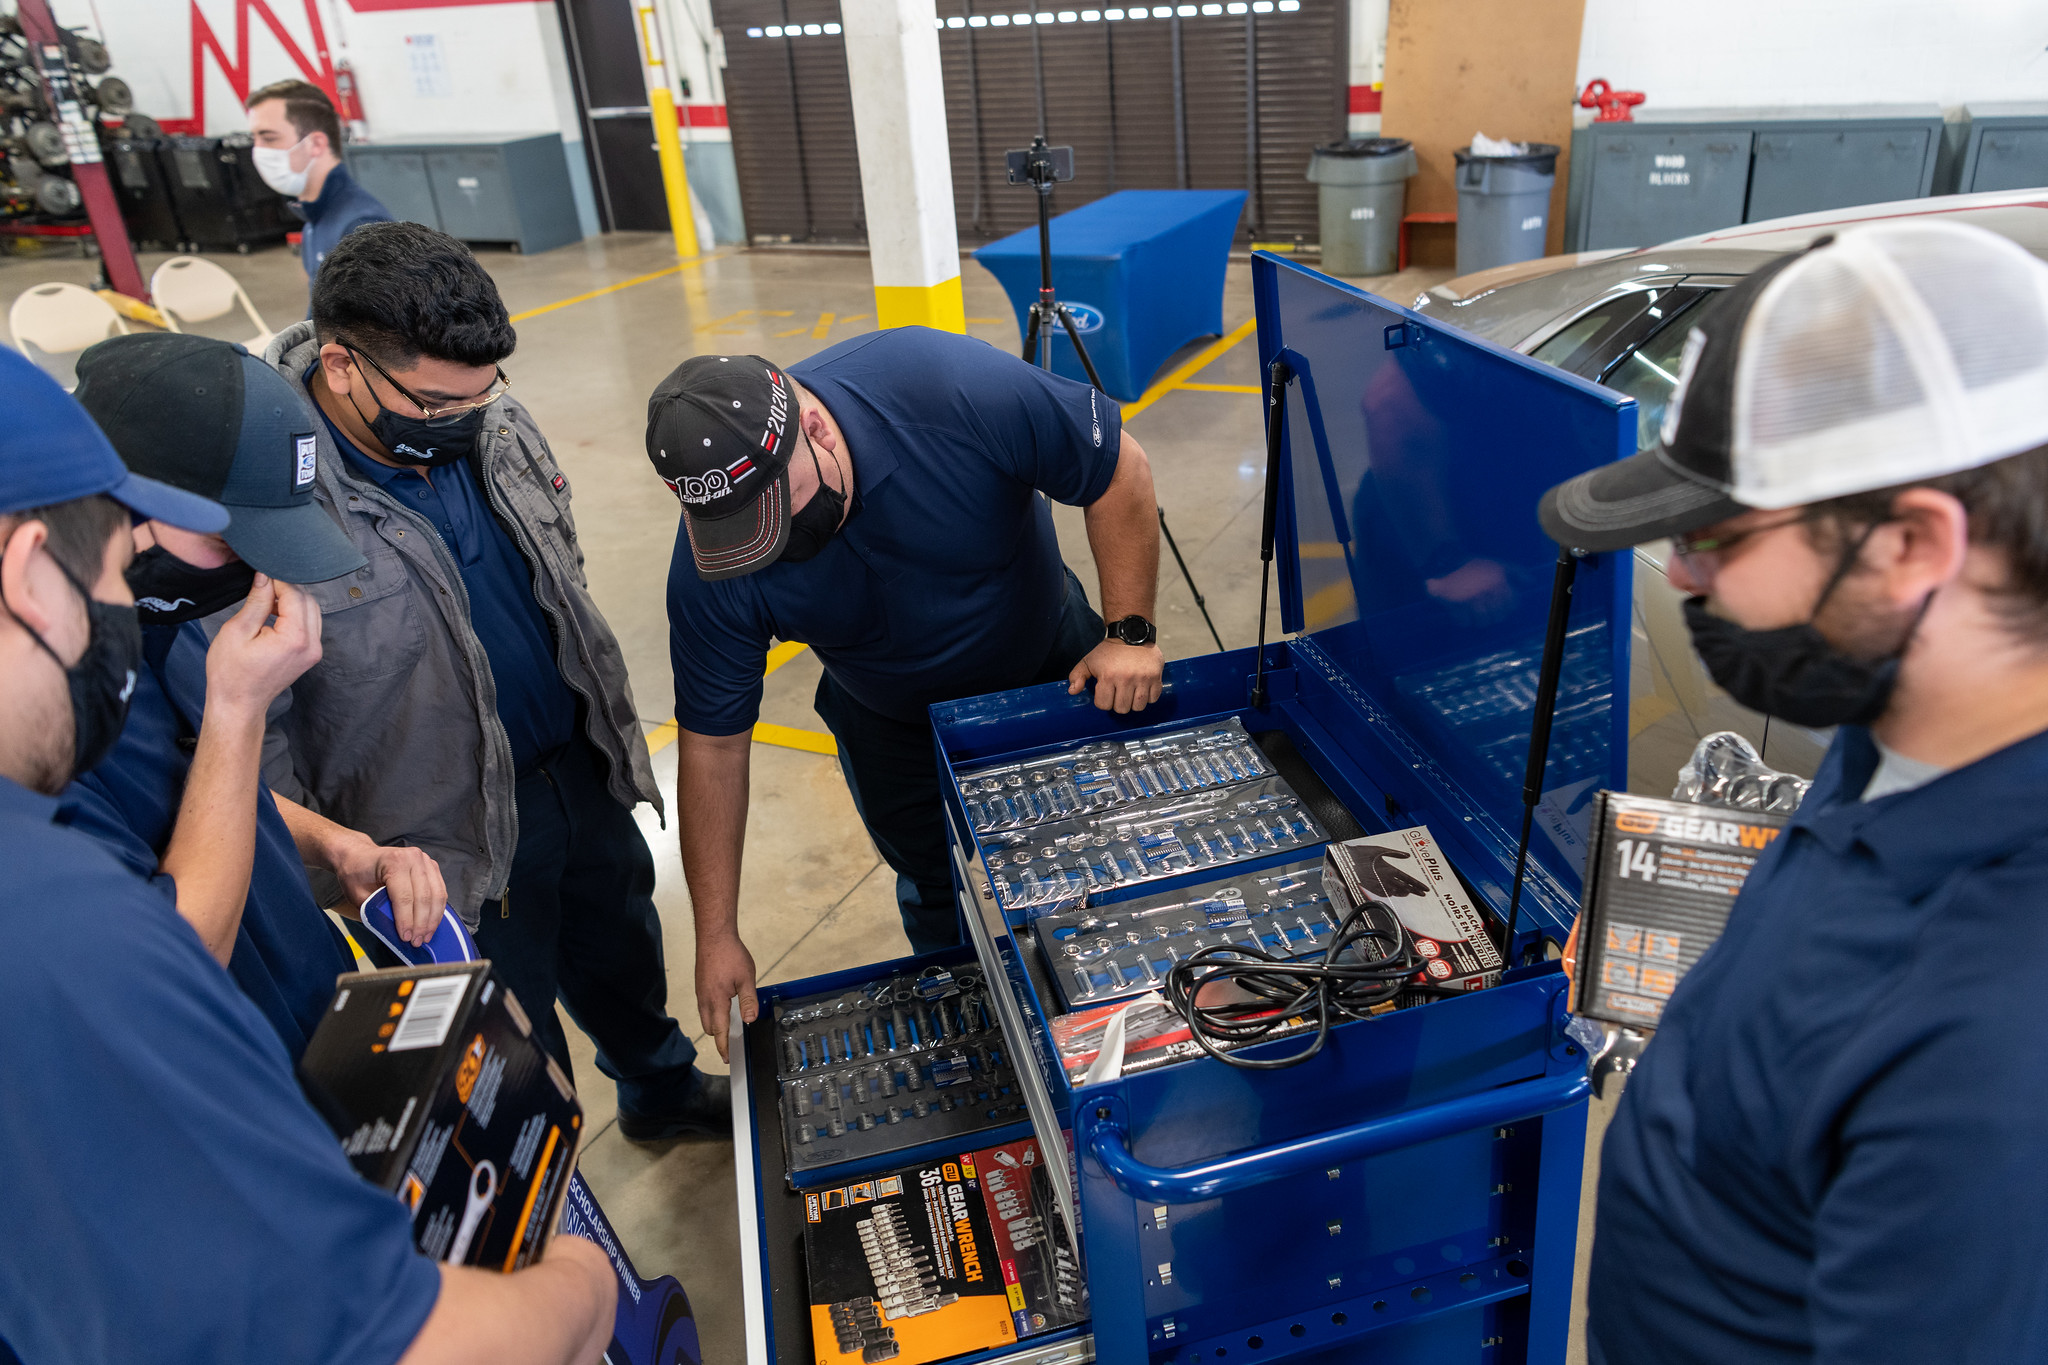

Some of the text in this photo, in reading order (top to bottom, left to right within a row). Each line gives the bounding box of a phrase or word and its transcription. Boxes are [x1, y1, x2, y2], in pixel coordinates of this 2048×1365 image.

[1649, 171, 1691, 185] BLOCKS
[1655, 154, 1686, 168] WOOD
[767, 384, 788, 434] 2020
[1616, 839, 1657, 882] 14
[1443, 893, 1463, 920] NOIRS
[1459, 921, 1471, 933] EN
[1467, 935, 1494, 968] NITRILE
[1460, 904, 1481, 932] BLACK
[1477, 931, 1502, 966] NITRILE
[918, 1166, 942, 1187] 36
[569, 1177, 641, 1304] SCHOLARSHIP WINNER
